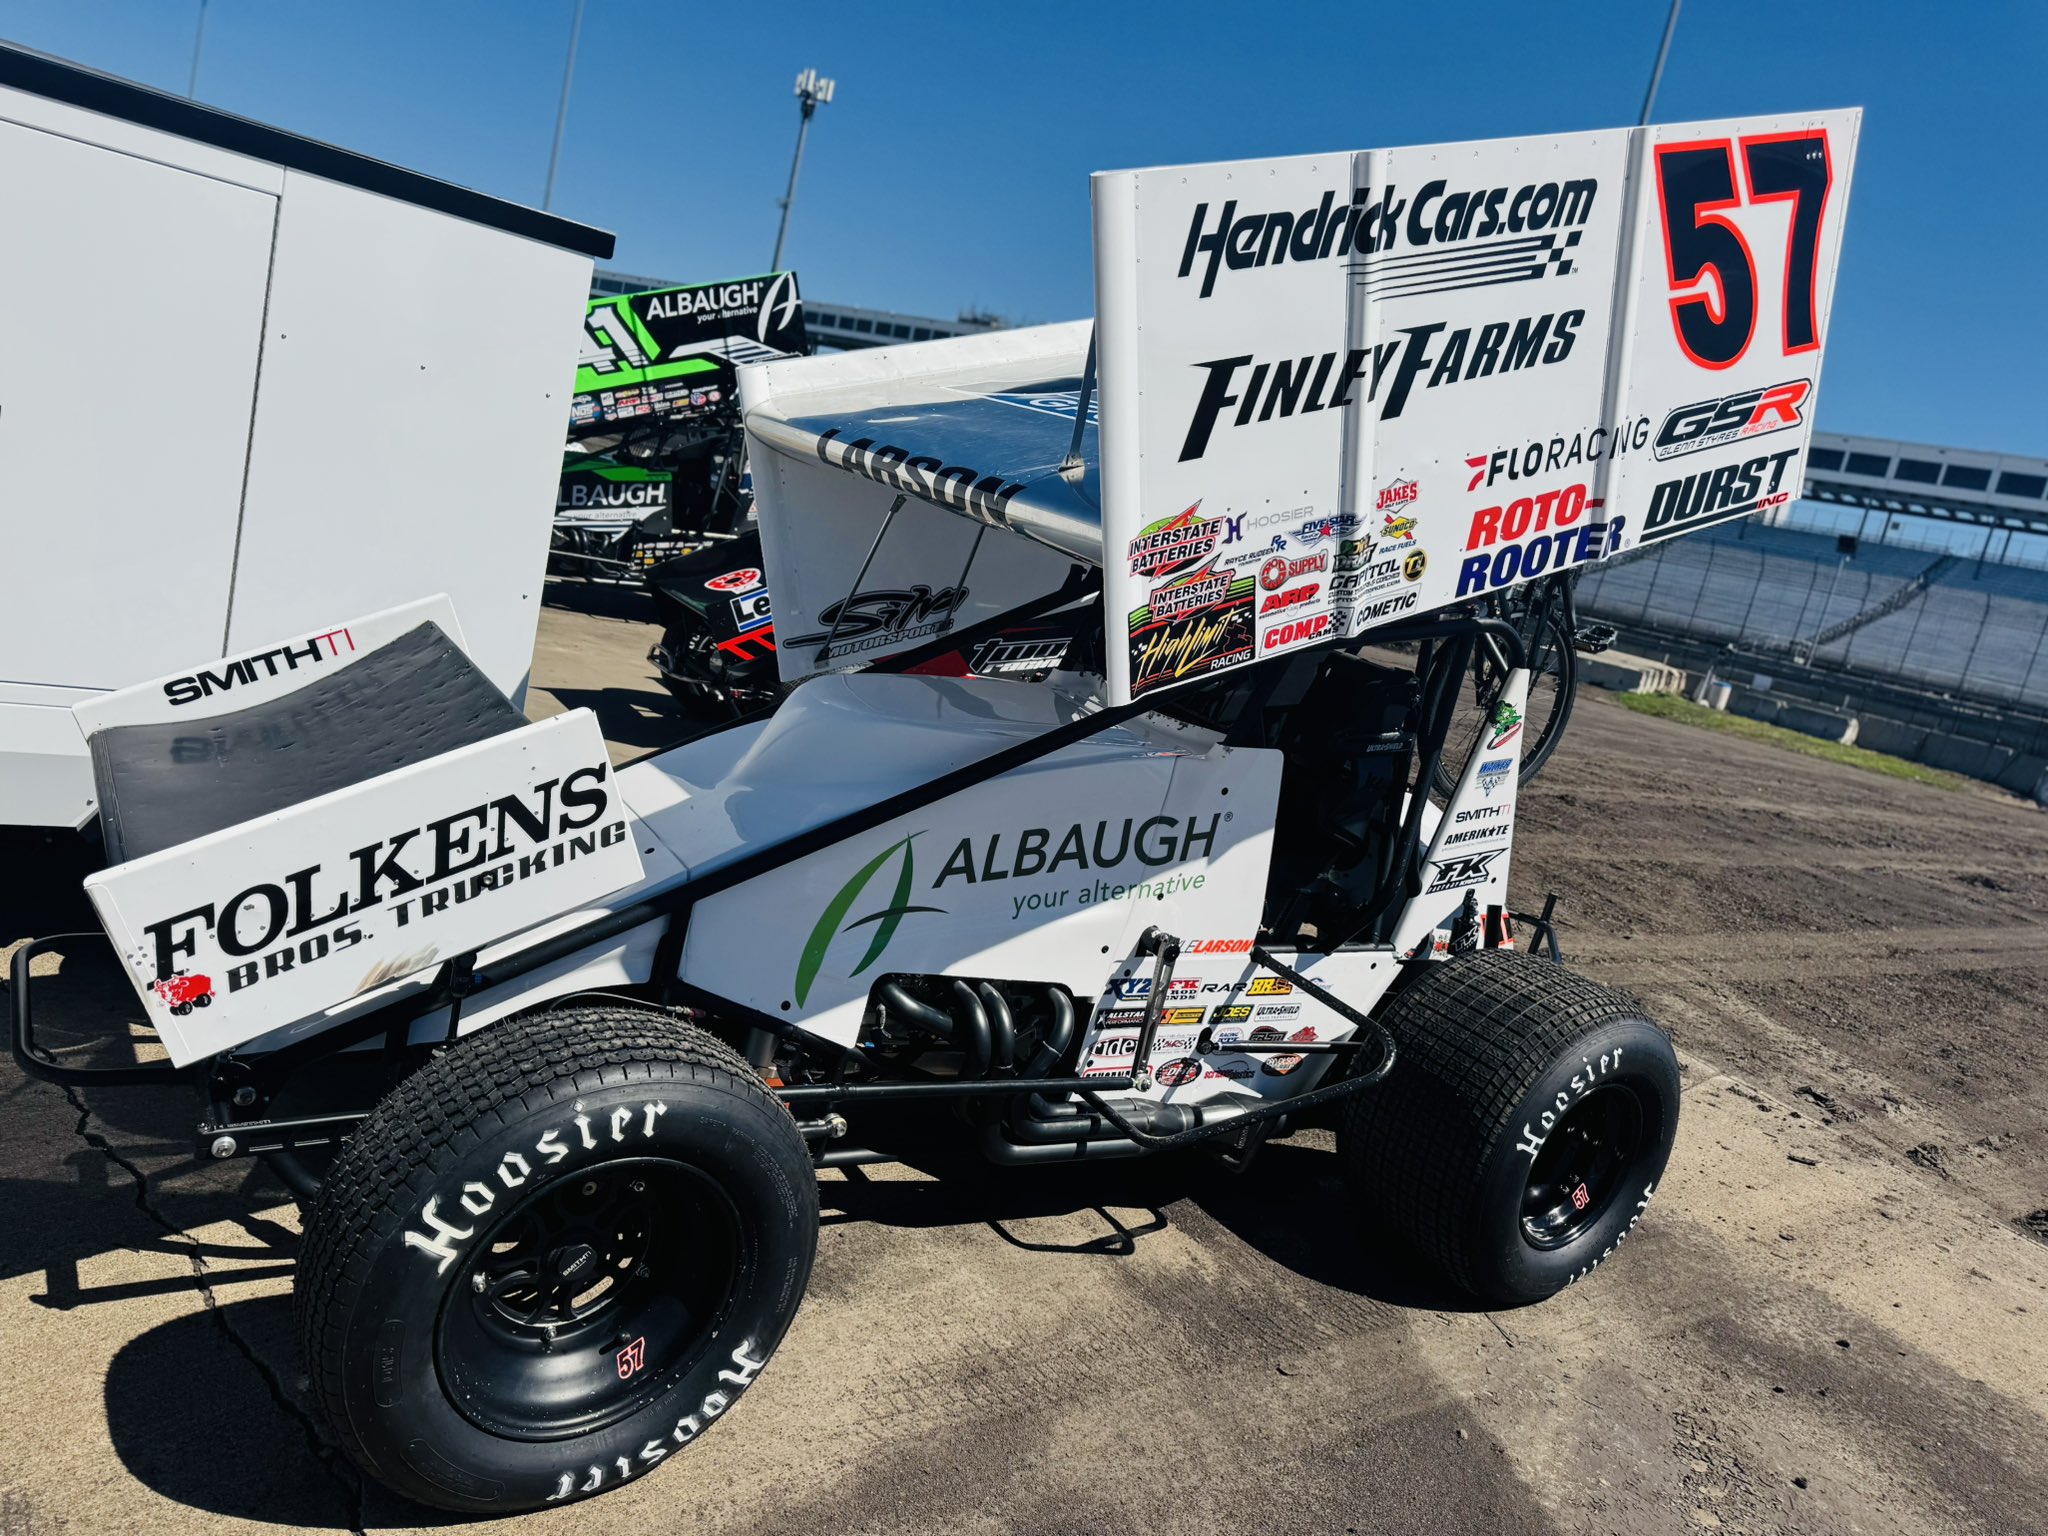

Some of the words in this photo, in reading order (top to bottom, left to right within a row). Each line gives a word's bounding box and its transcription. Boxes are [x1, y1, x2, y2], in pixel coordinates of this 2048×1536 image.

[1653, 129, 1833, 370] 57
[646, 281, 759, 321] ALBAUGH
[697, 312, 715, 325] your
[718, 305, 759, 319] lternative
[1655, 382, 1809, 448] GSR
[1659, 440, 1697, 457] GLENN
[1697, 429, 1740, 448] STYRES
[1740, 419, 1778, 436] RACING
[816, 428, 1028, 535] LARSON
[1376, 481, 1418, 510] JAKES
[1642, 448, 1800, 531] DURST
[1465, 483, 1606, 550] ROTO-
[1756, 492, 1790, 509] INC
[1247, 505, 1314, 531] HOOSIER
[1302, 518, 1326, 533] FIVE
[1382, 520, 1416, 536] SUNOCO
[1129, 519, 1221, 557] INTERSTATE
[1379, 542, 1397, 555] RACE
[1397, 540, 1417, 550] FUELS
[1132, 538, 1214, 573] BATTERIES
[1289, 554, 1326, 577] SUPPLY
[1455, 515, 1627, 599] ROOTER
[1154, 576, 1228, 605] INTERSTATE
[1329, 559, 1400, 590] CAPITOL
[1157, 589, 1223, 616] BATTERIES
[1260, 583, 1320, 614] ARP
[1357, 592, 1417, 626] COMETIC
[827, 619, 955, 658] MOTORSPORTS
[1264, 615, 1328, 649] COMP
[1308, 625, 1339, 640] CAMS
[163, 628, 355, 706] SMITHTI
[1210, 649, 1251, 670] RACING
[1455, 804, 1511, 823] SMITHTI
[144, 762, 608, 992] FOLKENS
[1434, 851, 1501, 884] FK
[226, 921, 374, 994] BROS.
[386, 820, 628, 928] TRUCKING
[1012, 889, 1069, 919] your
[1077, 873, 1206, 905] alternative
[1193, 940, 1254, 953] LARSON
[1201, 983, 1248, 993] RAR
[1213, 1007, 1252, 1018] JOES
[1516, 1047, 1623, 1164] Hoosier
[405, 1101, 668, 1275] Hoosier
[1572, 1182, 1590, 1210] 57
[616, 1336, 645, 1380] 57
